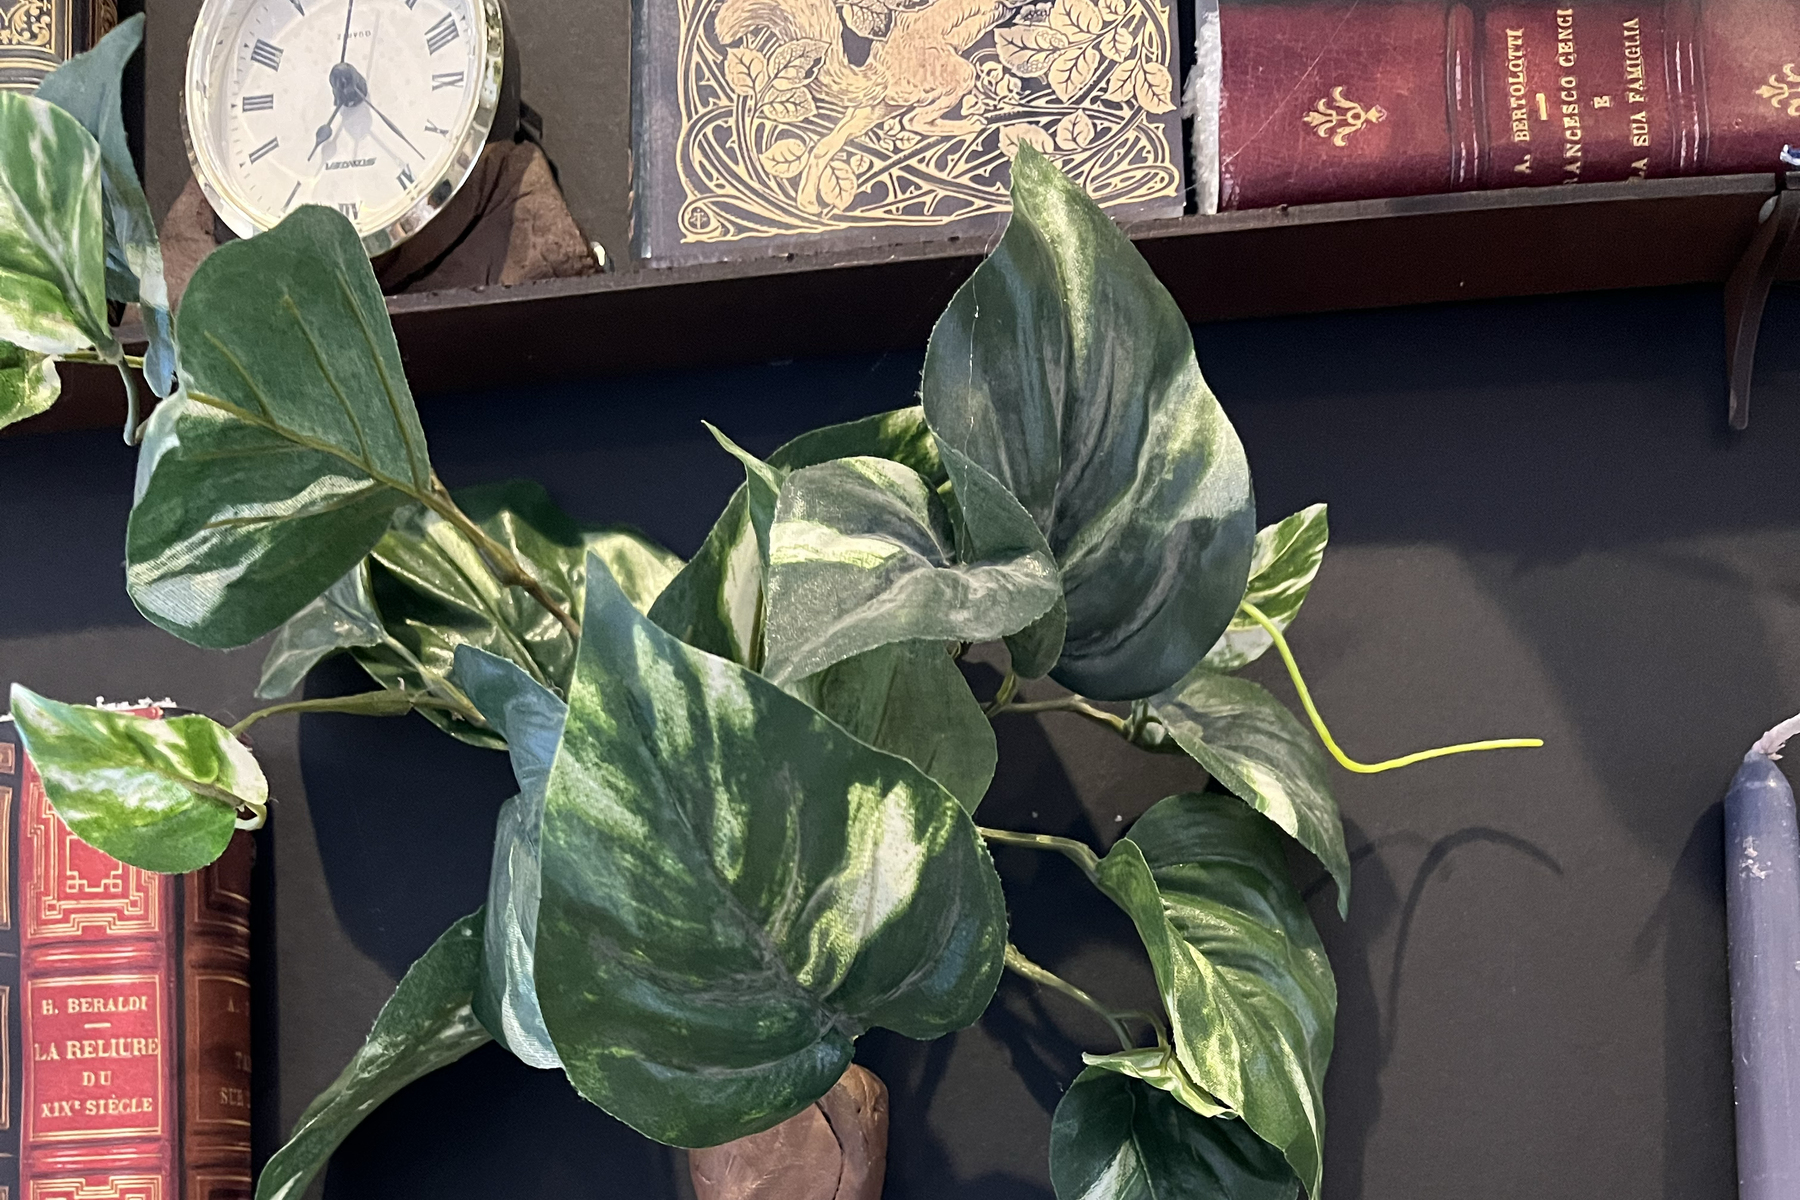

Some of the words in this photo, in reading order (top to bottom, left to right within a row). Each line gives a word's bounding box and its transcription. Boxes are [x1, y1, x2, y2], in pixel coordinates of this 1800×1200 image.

[1556, 8, 1576, 67] CENCI
[1622, 18, 1645, 104] FAMIGLIA
[1506, 27, 1531, 142] BERTOLOTTI
[1593, 95, 1612, 109] E
[1630, 111, 1650, 147] SUA
[1513, 154, 1532, 174] A.
[42, 998, 59, 1015] H.
[67, 995, 148, 1013] BERALDI
[34, 1042, 61, 1061] LA
[66, 1037, 159, 1059] RELIURE
[82, 1070, 112, 1086] DU
[85, 1093, 153, 1116] SIÈCLE
